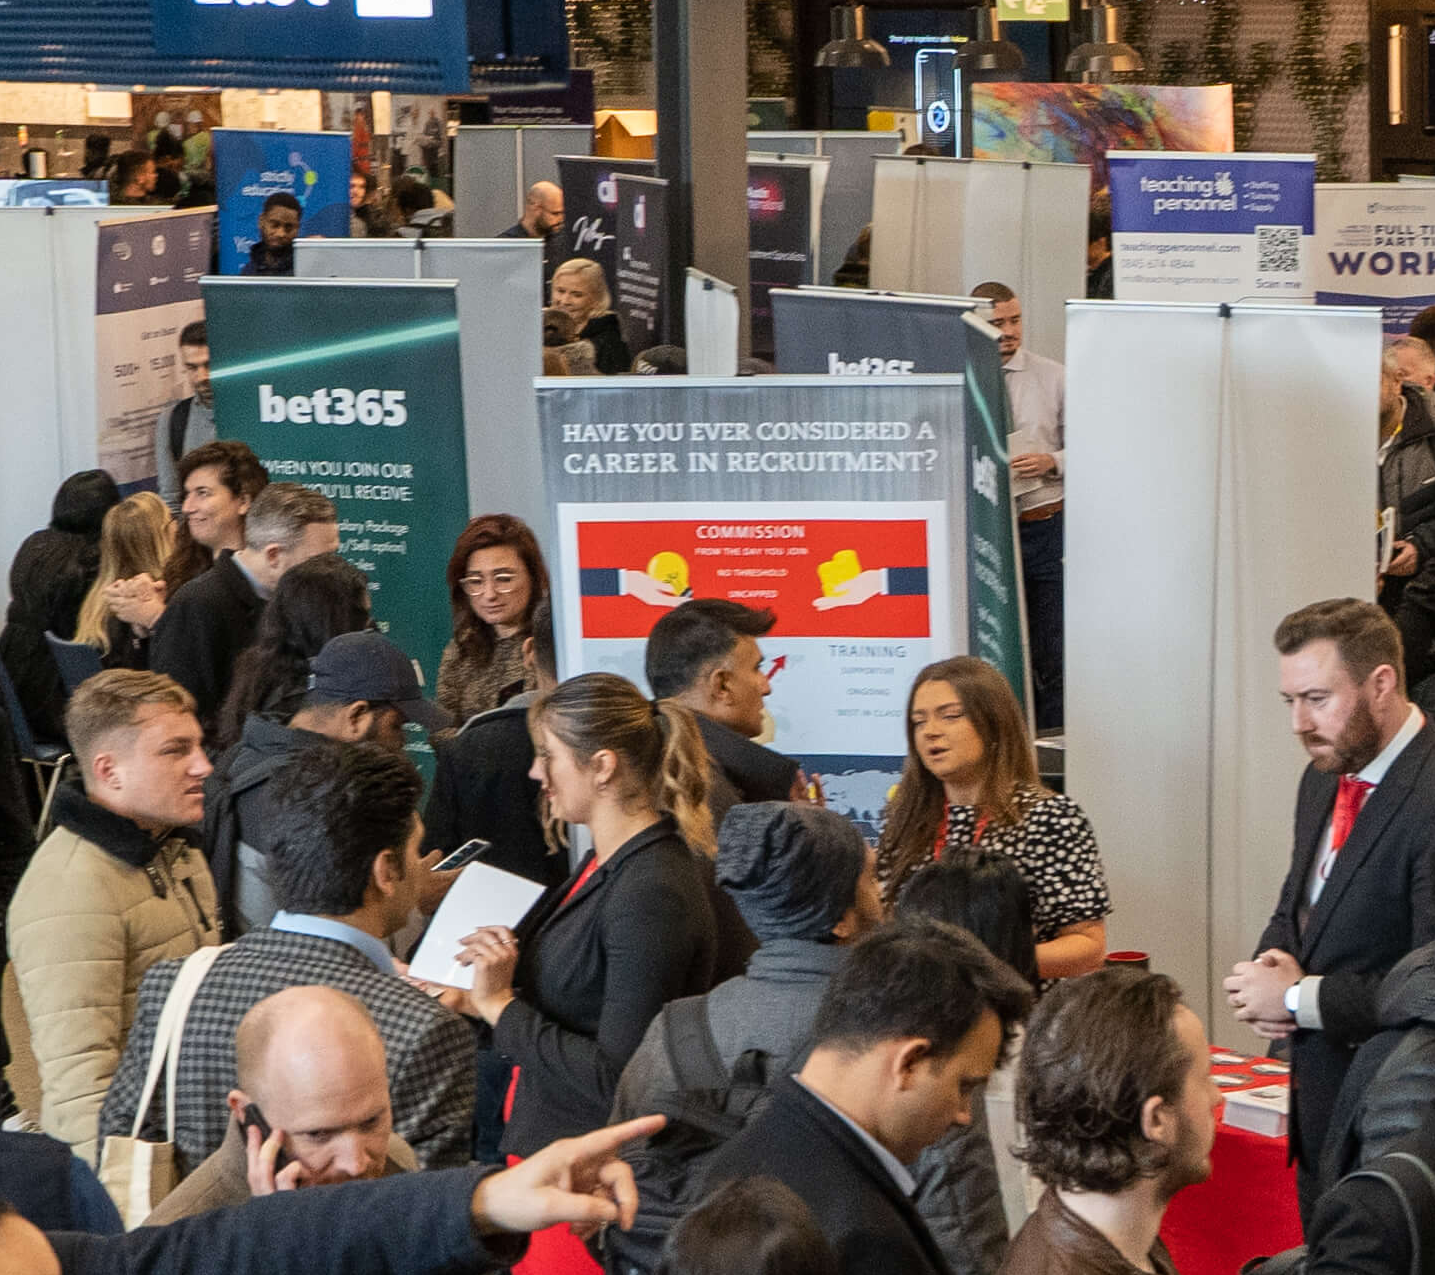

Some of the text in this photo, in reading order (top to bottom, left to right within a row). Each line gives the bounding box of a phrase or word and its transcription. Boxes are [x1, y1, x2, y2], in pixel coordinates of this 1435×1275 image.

[1140, 175, 1215, 197] teaching
[1153, 194, 1238, 215] personnel
[1374, 225, 1415, 235] FULL
[1374, 236, 1416, 246] PART
[258, 385, 408, 426] bet365
[562, 421, 937, 443] HAVE YOU EVER CONSIDERED A
[310, 460, 343, 476] YOU
[343, 462, 379, 477] JOIN
[381, 463, 414, 479] OUR
[564, 449, 939, 475] CAREER IN RECRUITMENT?
[695, 525, 806, 540] COMMISSION
[828, 644, 908, 658] TRAINING
